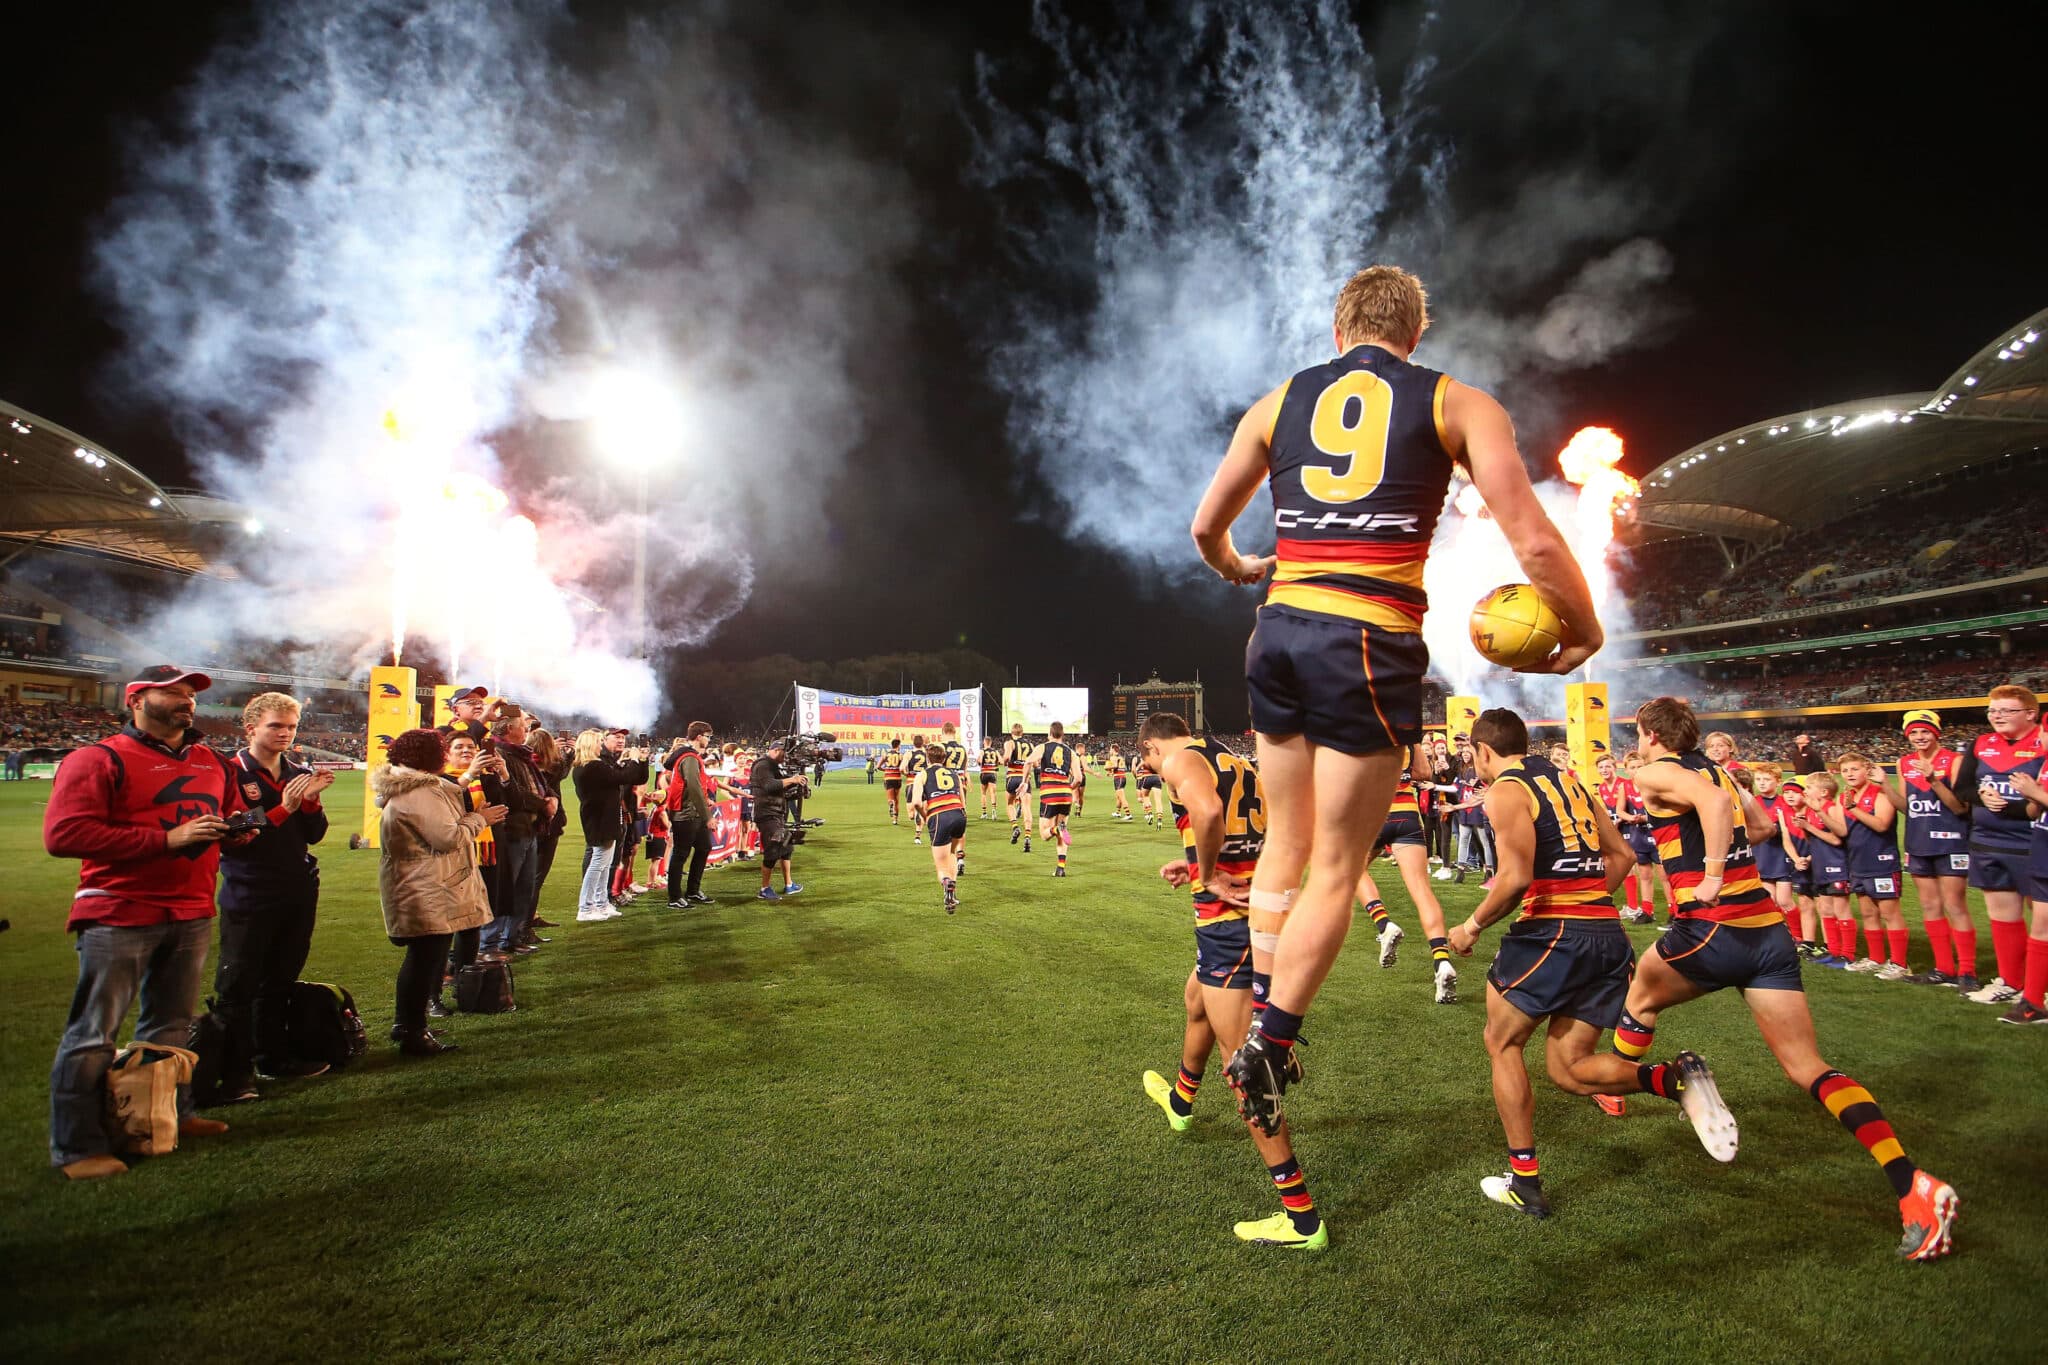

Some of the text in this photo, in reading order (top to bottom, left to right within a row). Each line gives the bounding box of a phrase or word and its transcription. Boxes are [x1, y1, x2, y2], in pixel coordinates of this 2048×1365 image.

[1300, 369, 1394, 504] 9
[1275, 507, 1419, 533] C-HR
[863, 731, 875, 740] WE
[965, 706, 975, 755] TOYOTA
[886, 753, 899, 767] 30
[946, 746, 965, 769] 27
[984, 751, 996, 764] 33
[1017, 741, 1030, 761] 12
[1051, 745, 1065, 769] 4
[913, 754, 925, 772] 2
[935, 767, 955, 791] 6
[1532, 771, 1602, 853] 18
[1552, 856, 1604, 872] C-H
